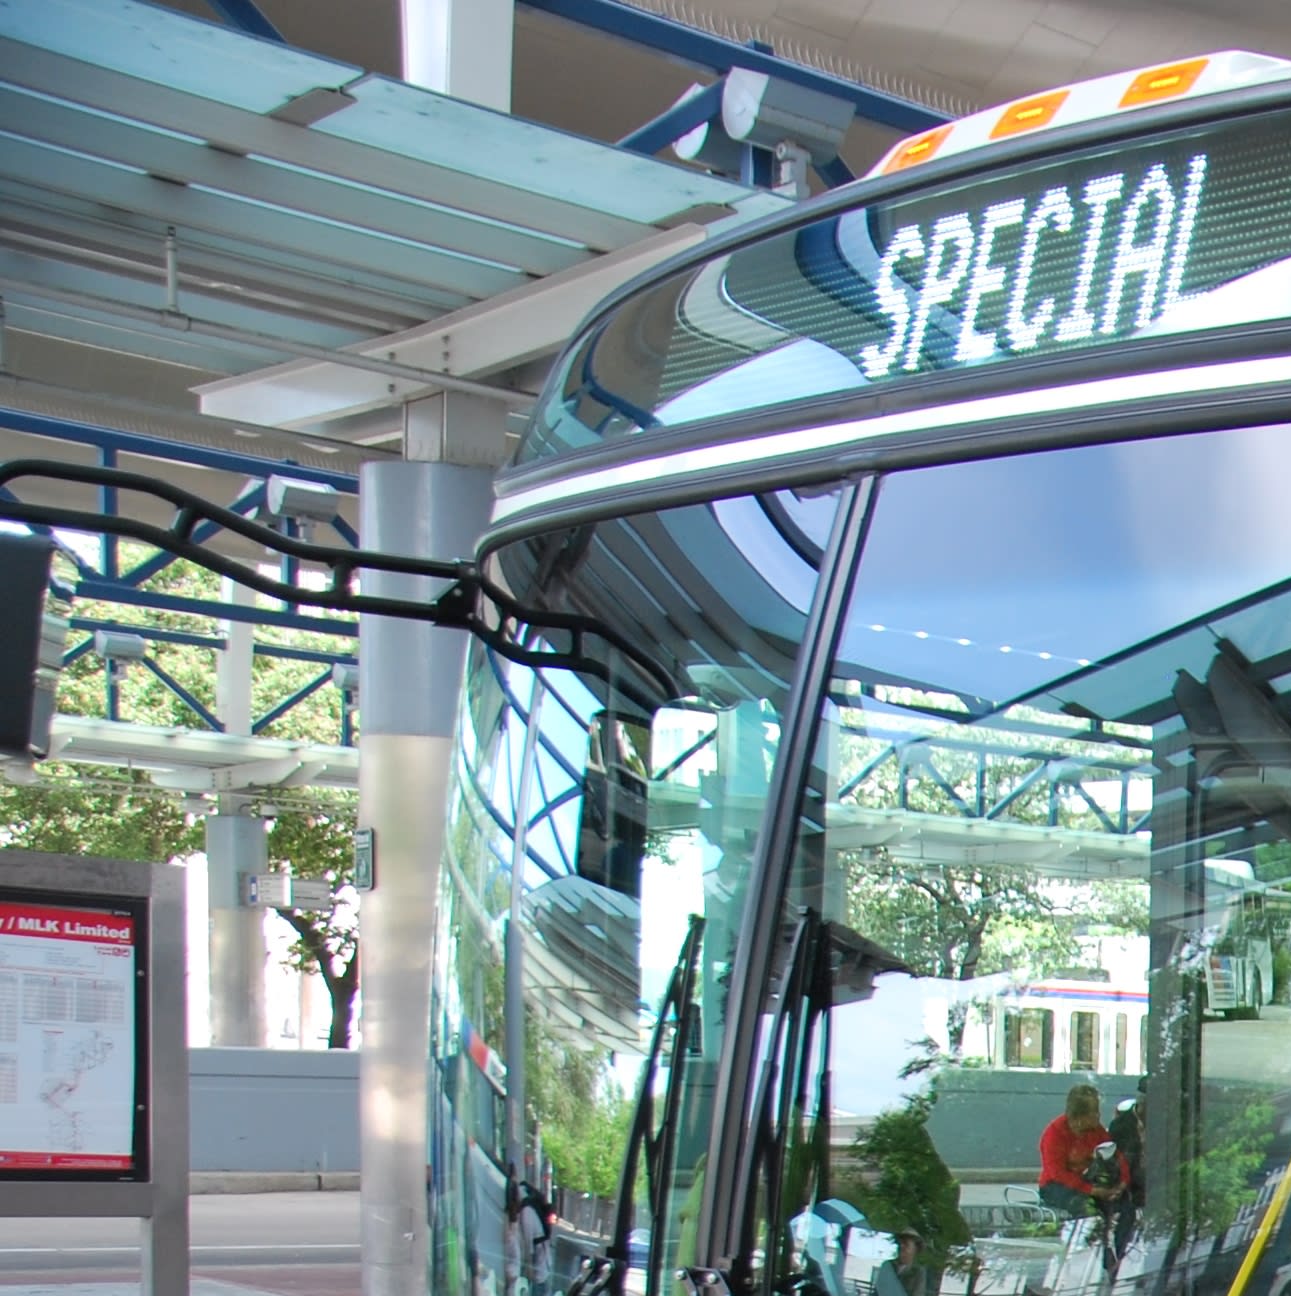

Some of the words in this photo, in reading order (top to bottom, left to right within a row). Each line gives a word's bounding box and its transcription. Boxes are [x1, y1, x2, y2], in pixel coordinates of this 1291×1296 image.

[858, 154, 1208, 379] SPECIAL
[18, 916, 60, 933] MLK
[64, 921, 131, 940] Limited
